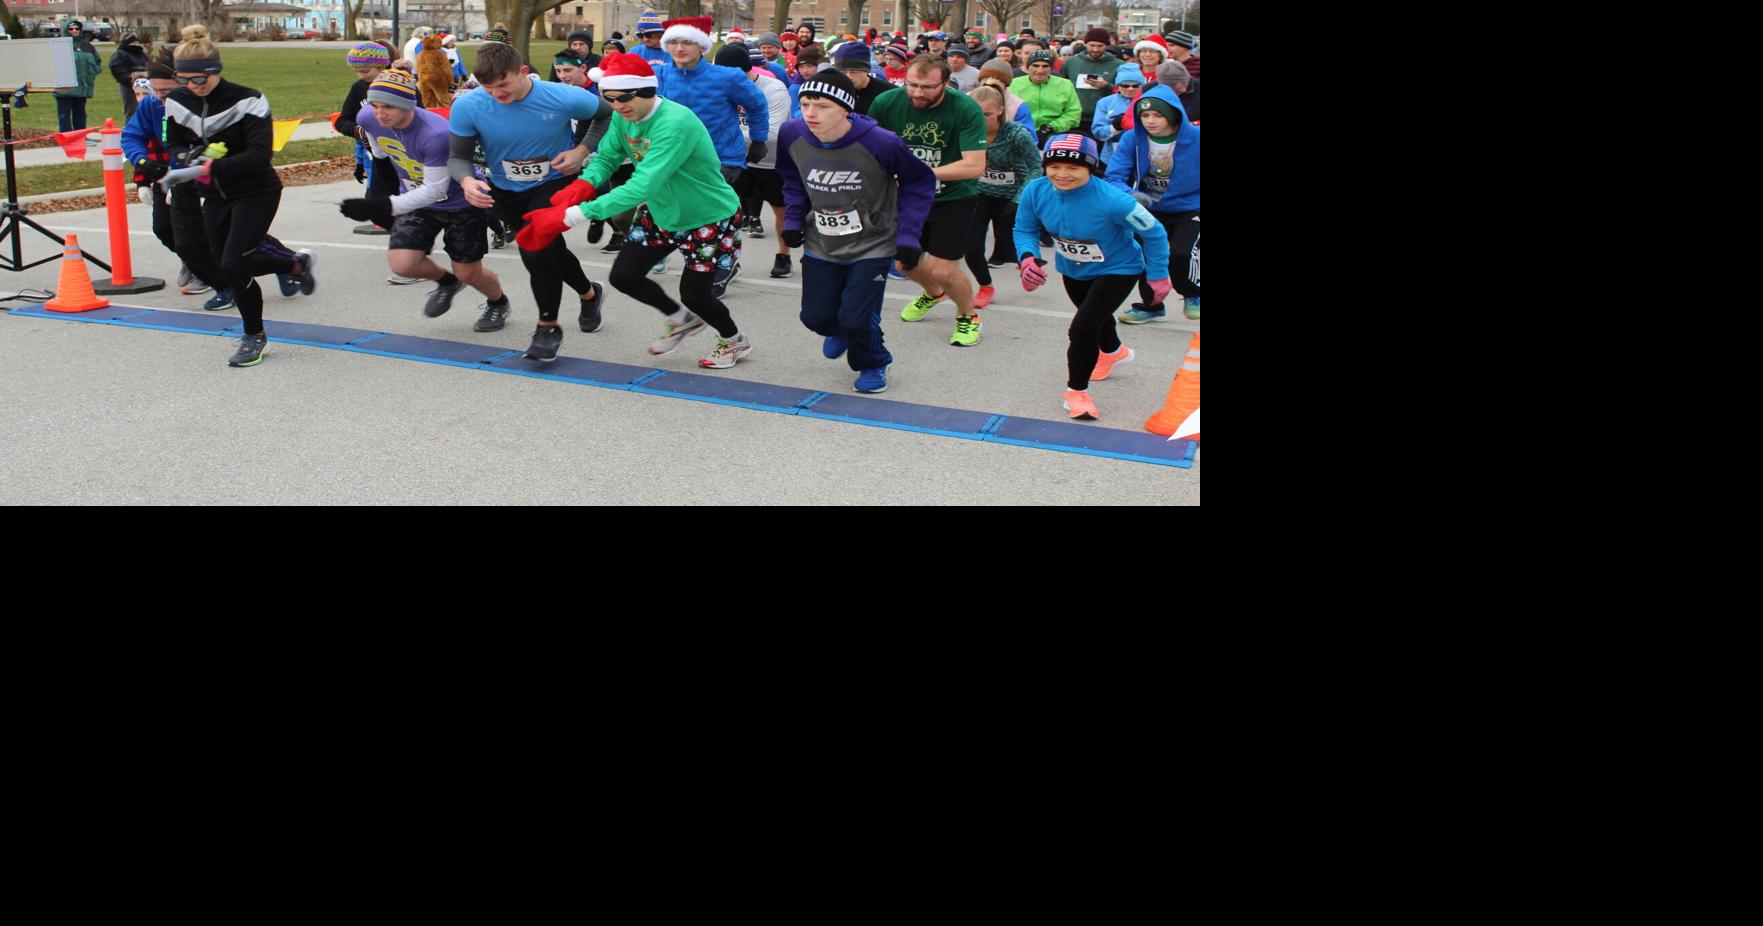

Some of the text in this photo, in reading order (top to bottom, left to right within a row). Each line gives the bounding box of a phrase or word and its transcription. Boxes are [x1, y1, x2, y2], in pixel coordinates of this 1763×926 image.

[909, 147, 942, 162] OM
[1046, 150, 1080, 159] USA
[511, 165, 542, 175] 363
[807, 168, 862, 185] KIEL
[807, 182, 829, 192] TRACK
[818, 215, 850, 227] 383
[1057, 241, 1090, 255] 362
